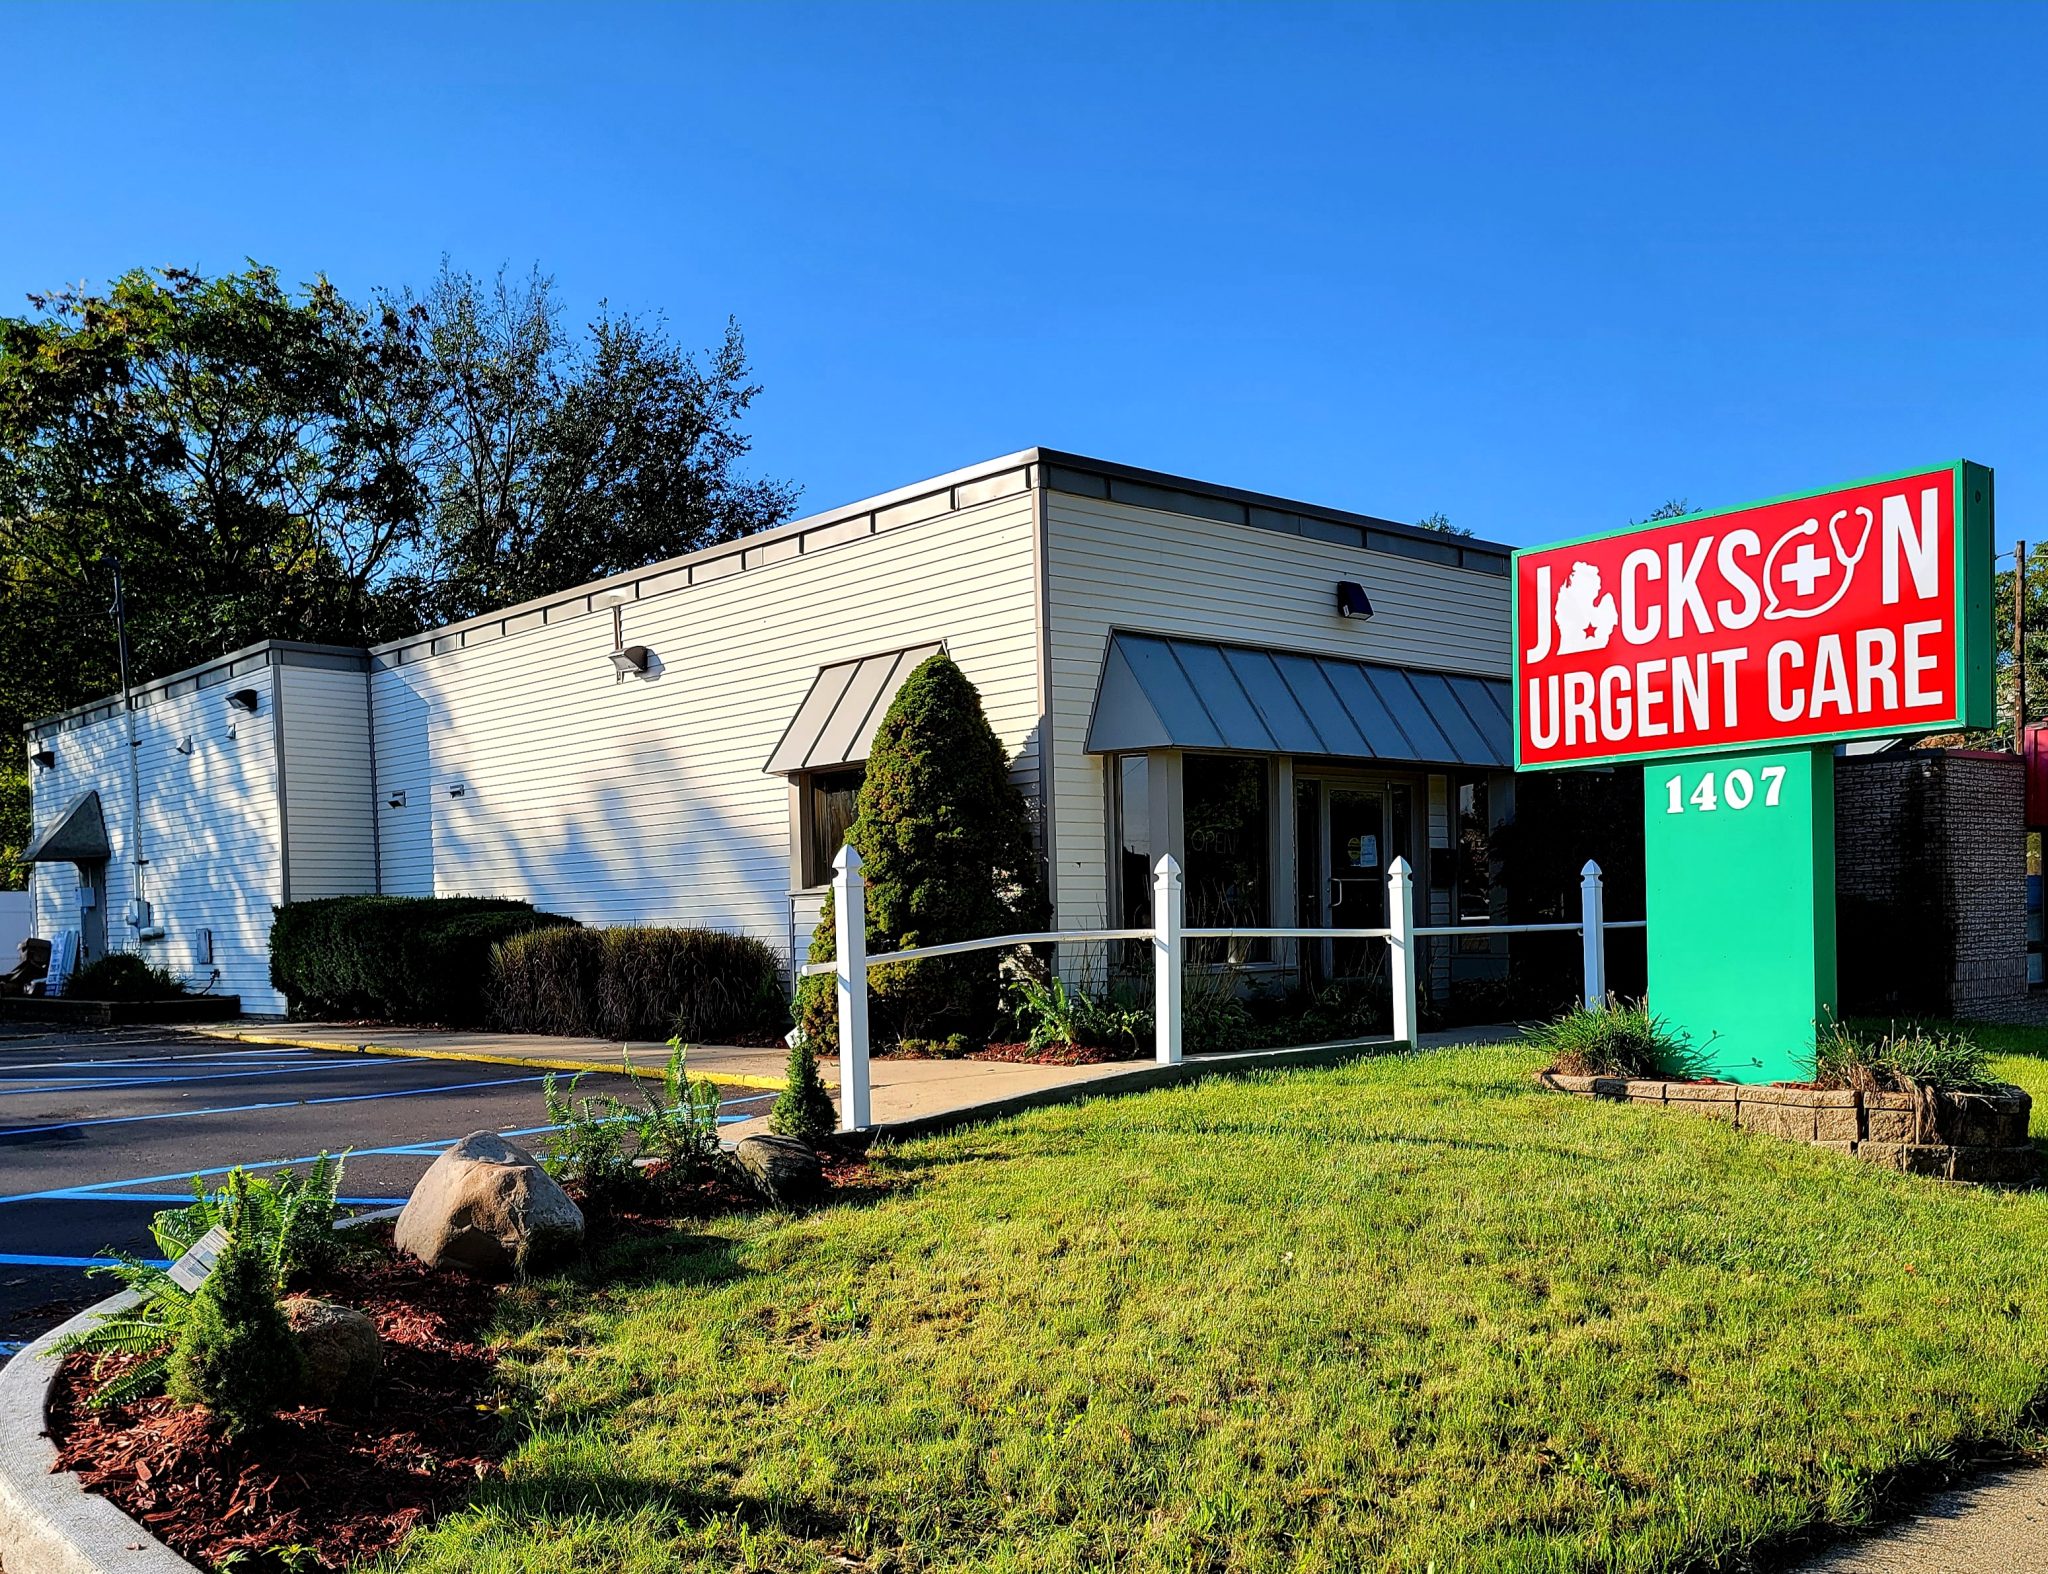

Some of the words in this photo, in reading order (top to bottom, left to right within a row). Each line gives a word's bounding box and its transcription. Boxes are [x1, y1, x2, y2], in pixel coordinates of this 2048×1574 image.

[1529, 646, 1750, 750] URGENT
[1767, 619, 1944, 722] CARE
[1664, 765, 1787, 815] 1407
[1191, 829, 1237, 855] OPEN
